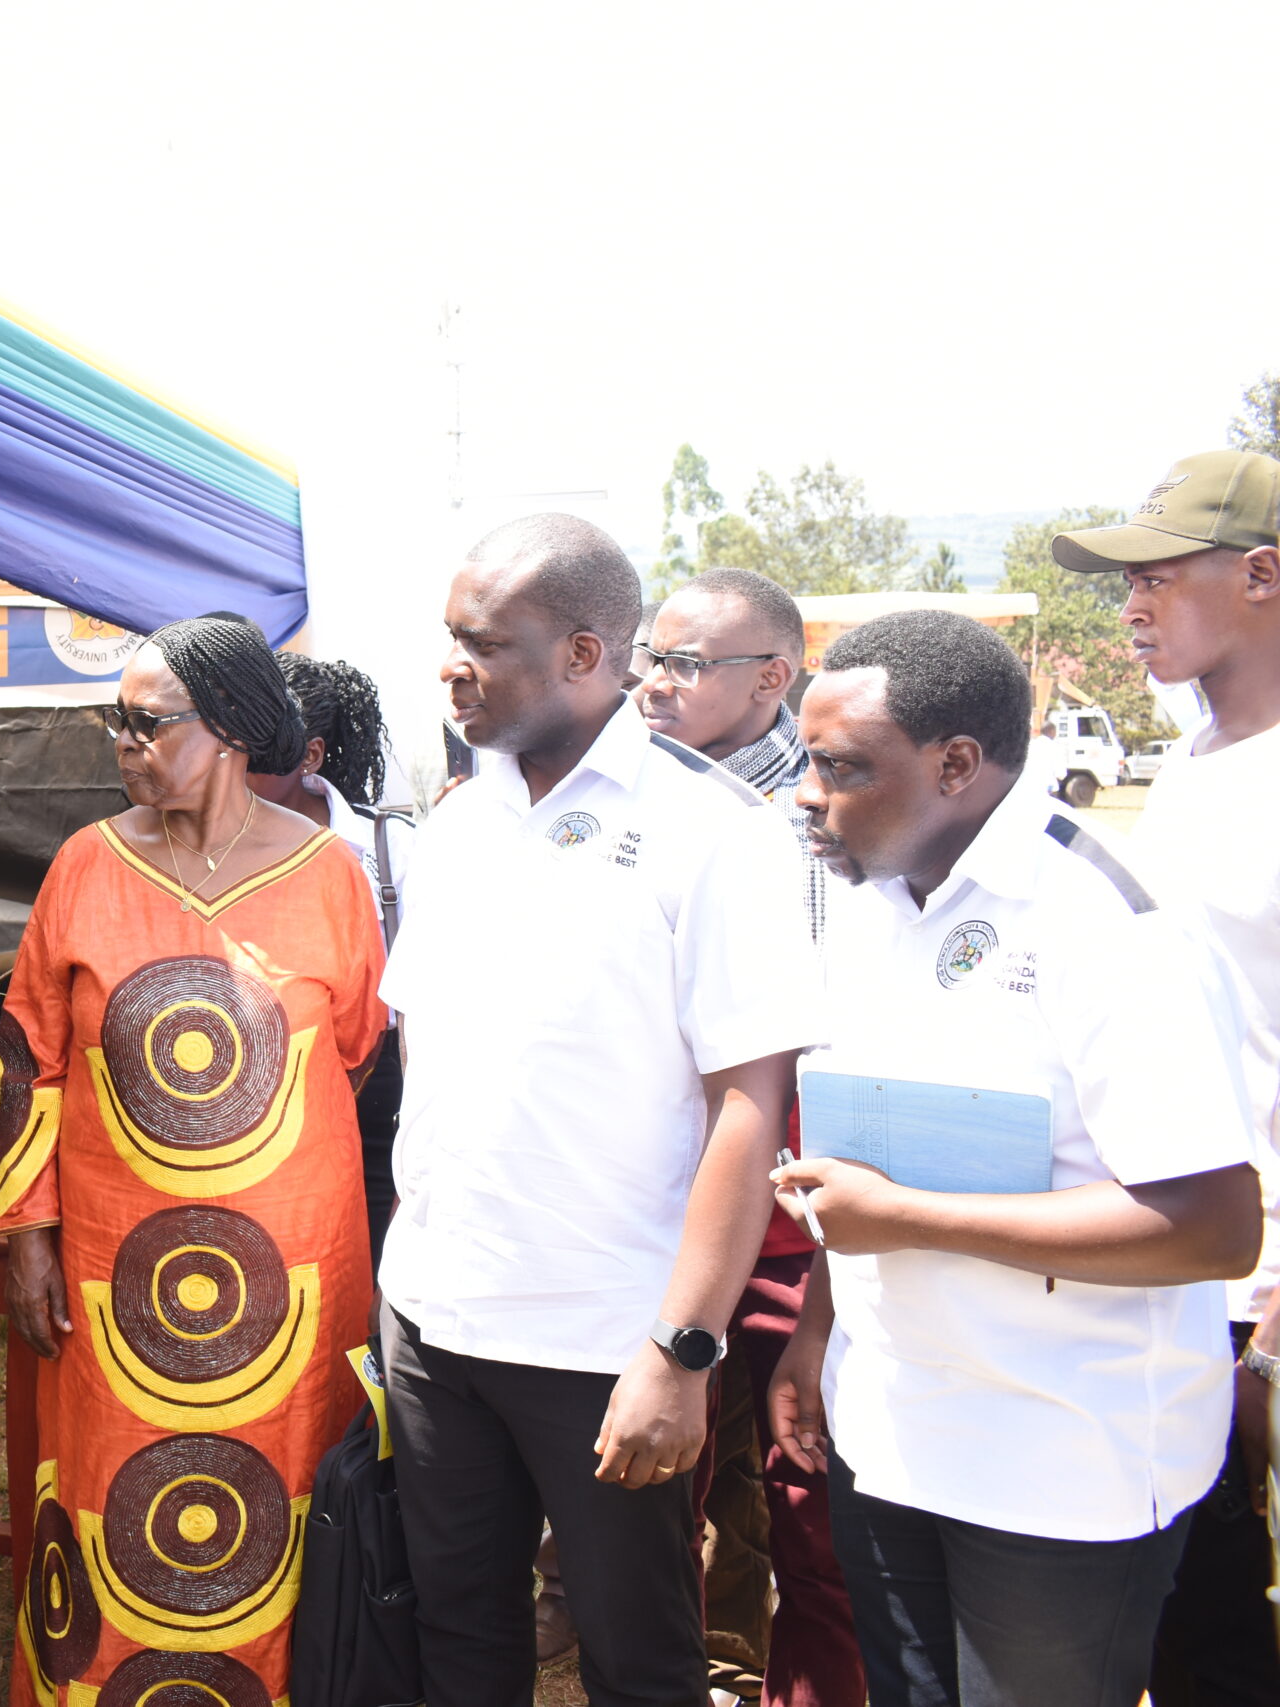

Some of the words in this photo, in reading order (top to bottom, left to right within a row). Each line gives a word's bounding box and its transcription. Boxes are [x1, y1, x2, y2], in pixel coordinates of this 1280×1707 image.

[54, 634, 108, 663] UNIVERSITY
[112, 632, 141, 659] ABALE
[614, 854, 638, 869] BEST
[1007, 980, 1036, 995] BEST
